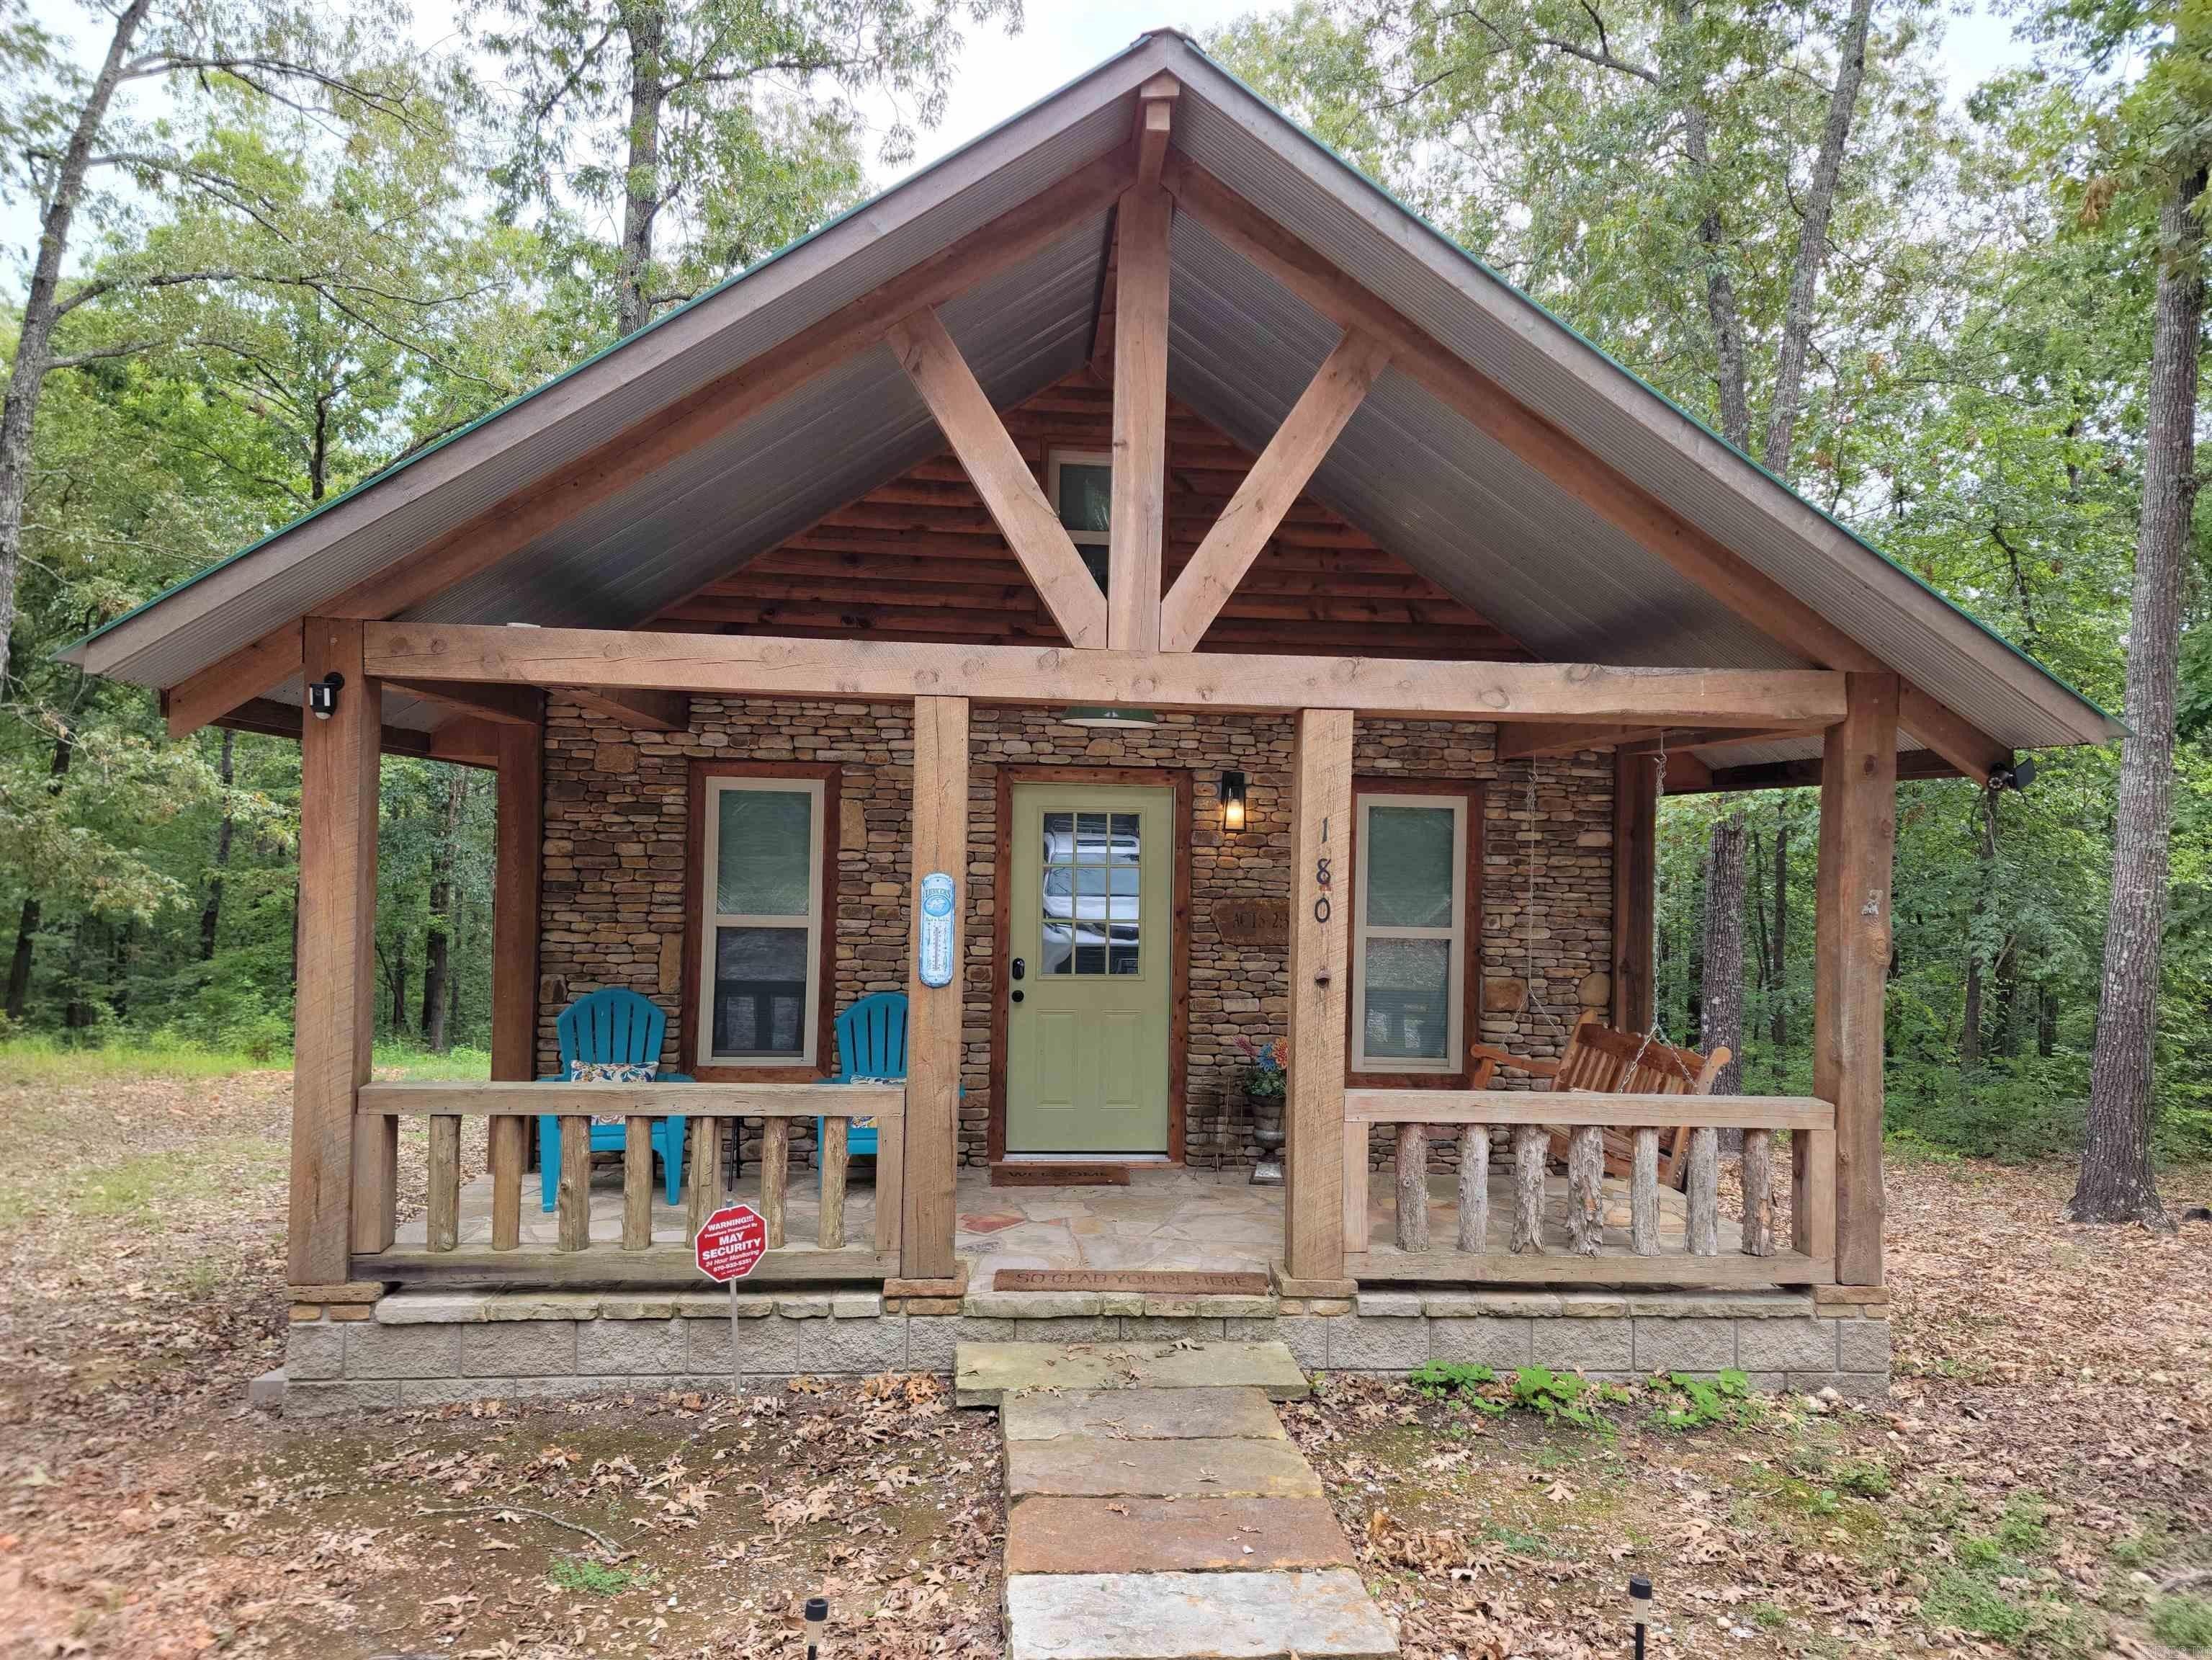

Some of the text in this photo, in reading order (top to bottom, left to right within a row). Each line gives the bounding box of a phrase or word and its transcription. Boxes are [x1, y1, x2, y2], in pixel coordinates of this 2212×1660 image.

[1315, 817, 1331, 923] 180
[707, 1215, 754, 1231] WARNING!!!
[719, 1231, 744, 1246] MAY
[702, 1237, 761, 1260] SECURITY
[729, 1249, 760, 1261] Monitoring
[1016, 1272, 1044, 1283] SO
[1052, 1273, 1107, 1284] GLAD
[1193, 1275, 1250, 1286] HERE
